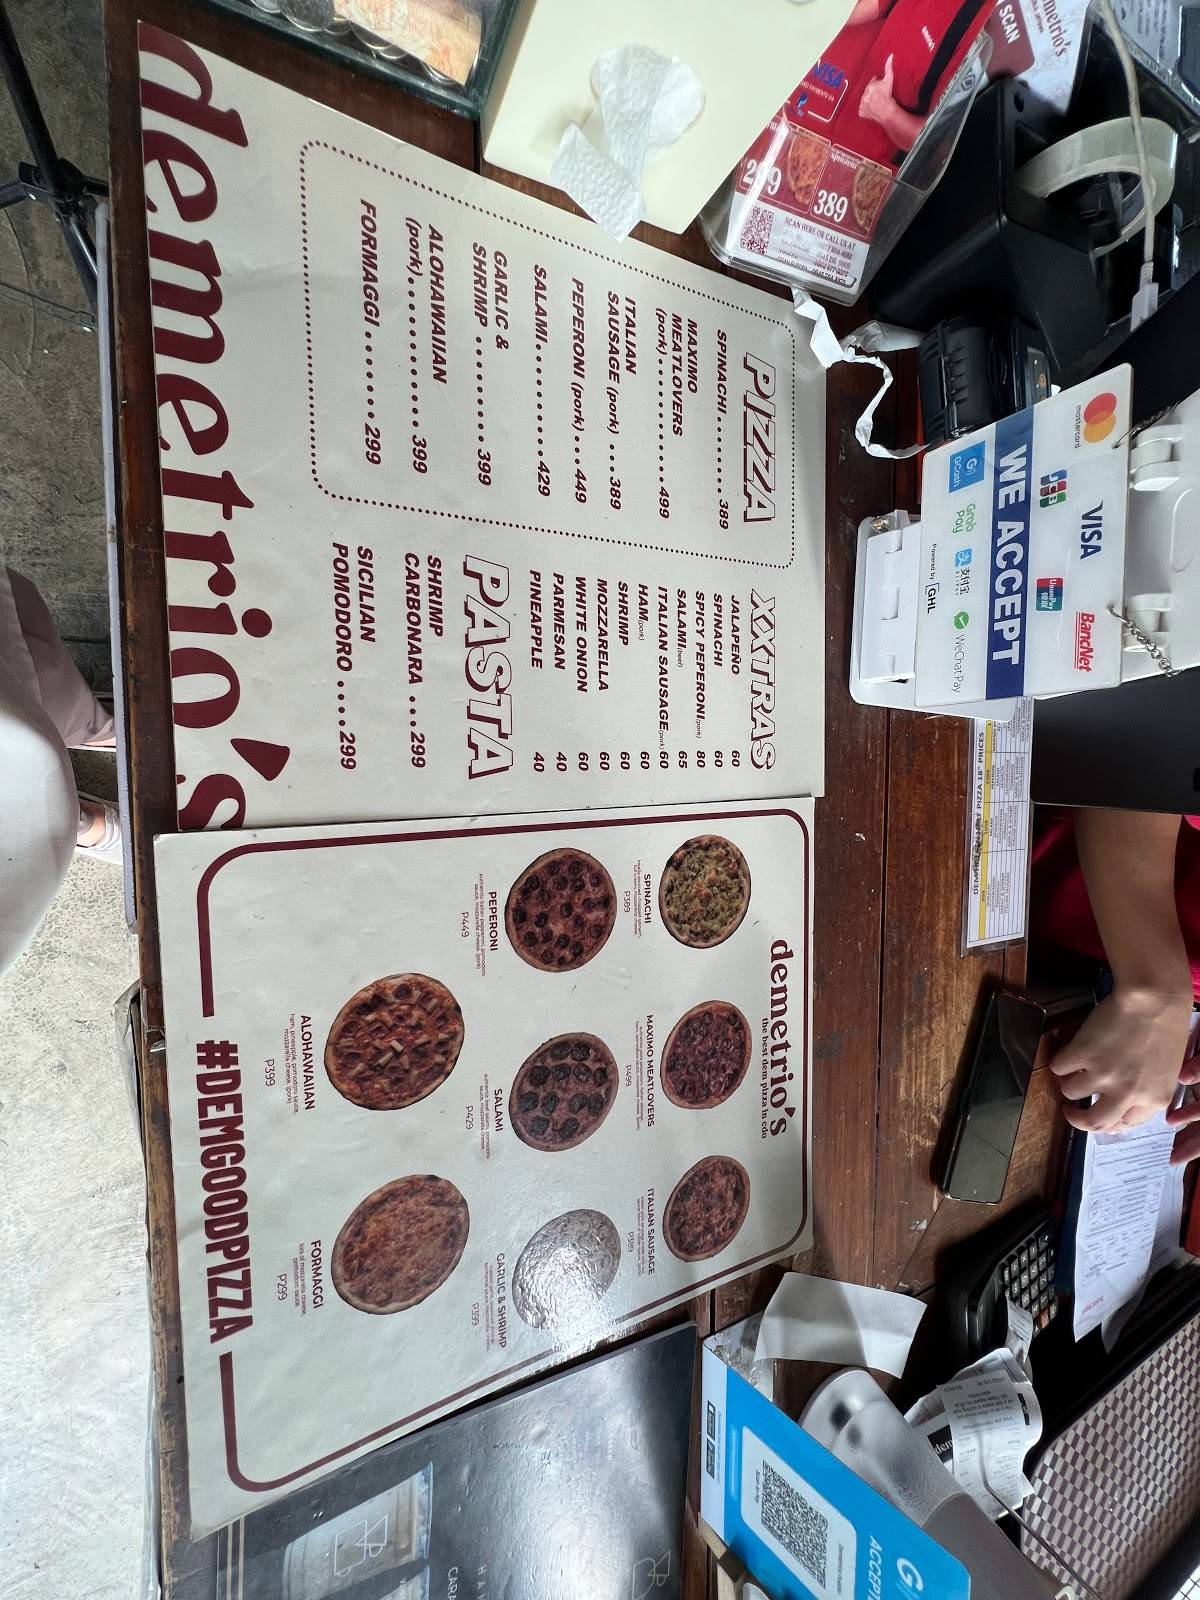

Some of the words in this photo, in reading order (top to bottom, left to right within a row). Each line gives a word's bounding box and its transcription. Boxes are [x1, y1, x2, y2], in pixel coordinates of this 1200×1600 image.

[999, 4, 1020, 44] SCAN
[1043, 0, 1072, 57] metrio's
[813, 190, 848, 222] 389
[360, 199, 380, 326] FORMAGGI
[406, 216, 422, 276] (pork)
[428, 224, 447, 384] ALOHAWAIIAN
[472, 242, 488, 328] SHRIMP
[494, 250, 508, 330] GARLIC
[534, 264, 547, 343] SALAMI
[496, 335, 508, 350] &
[572, 277, 584, 378] PEPERONI
[608, 290, 620, 383] SAUSAGE
[624, 296, 636, 374] ITALIAN
[656, 308, 667, 354] (pork)
[672, 313, 682, 436] MEATLOVERS
[688, 318, 698, 394] MAXIMO
[716, 329, 727, 414] SPINACHI
[571, 382, 584, 432] (pork)
[606, 386, 619, 434] (pork)
[1074, 405, 1082, 448] mastercard
[364, 423, 381, 464] 299
[412, 434, 428, 474] 399
[744, 352, 776, 522] PIZZA
[478, 448, 491, 486] 399
[538, 460, 550, 496] 429
[574, 468, 586, 503] 449
[953, 456, 962, 488] GCash
[998, 444, 1027, 509] WE
[610, 476, 621, 510] 389
[659, 486, 670, 519] 499
[718, 498, 728, 530] 389
[952, 510, 964, 534] Pay
[966, 504, 976, 532] Grab
[1080, 500, 1104, 560] VISA
[357, 546, 376, 642] SICILIAN
[428, 554, 444, 637] SHRIMP
[930, 572, 936, 580] by
[992, 521, 1024, 666] ACCEPT
[332, 542, 352, 672] POMODORO
[404, 552, 423, 684] CARBONARA
[530, 570, 542, 668] PINEAPPLE
[552, 572, 566, 670] PARMESAN
[576, 576, 587, 632] WHITE
[618, 581, 628, 646] SHRIMP
[658, 586, 668, 650] ITALIAN
[695, 590, 704, 638] SPICY
[928, 588, 936, 614] GHL
[598, 578, 608, 691] MOZZARELLA
[714, 593, 722, 666] SPINACHI
[731, 595, 742, 675] JALAPEÑO
[1077, 612, 1095, 672] BancNet
[463, 554, 513, 780] PASTA
[576, 636, 588, 692] ONION
[954, 634, 965, 674] WeChat
[750, 588, 776, 770] XXTRAS
[952, 676, 963, 692] Pay
[340, 730, 356, 770] 299
[410, 731, 426, 768] 299
[533, 752, 544, 772] 40
[556, 752, 567, 772] 40
[578, 752, 589, 771] 60
[600, 751, 610, 770] 60
[620, 751, 630, 770] 60
[640, 750, 650, 770] 60
[659, 750, 668, 768] 60
[678, 750, 688, 768] 65
[696, 750, 706, 768] 80
[714, 750, 723, 768] 60
[732, 750, 740, 768] 60
[488, 892, 498, 952] PEPERONI
[644, 874, 652, 924] SPINACHI
[646, 1014, 654, 1057] MAXIMO
[770, 940, 796, 1136] demetrio's
[300, 1015, 316, 1110] ALOHAWAIIAN
[494, 1088, 504, 1132] SALAMI
[760, 1082, 768, 1108] pizza
[762, 1110, 768, 1119] in
[196, 1040, 254, 1344] #DEMGOODPIZZA
[310, 1240, 324, 1308] FORMAGGI
[496, 1252, 506, 1292] GARLIC
[498, 1296, 506, 1304] &
[498, 1305, 506, 1348] SHRIMP
